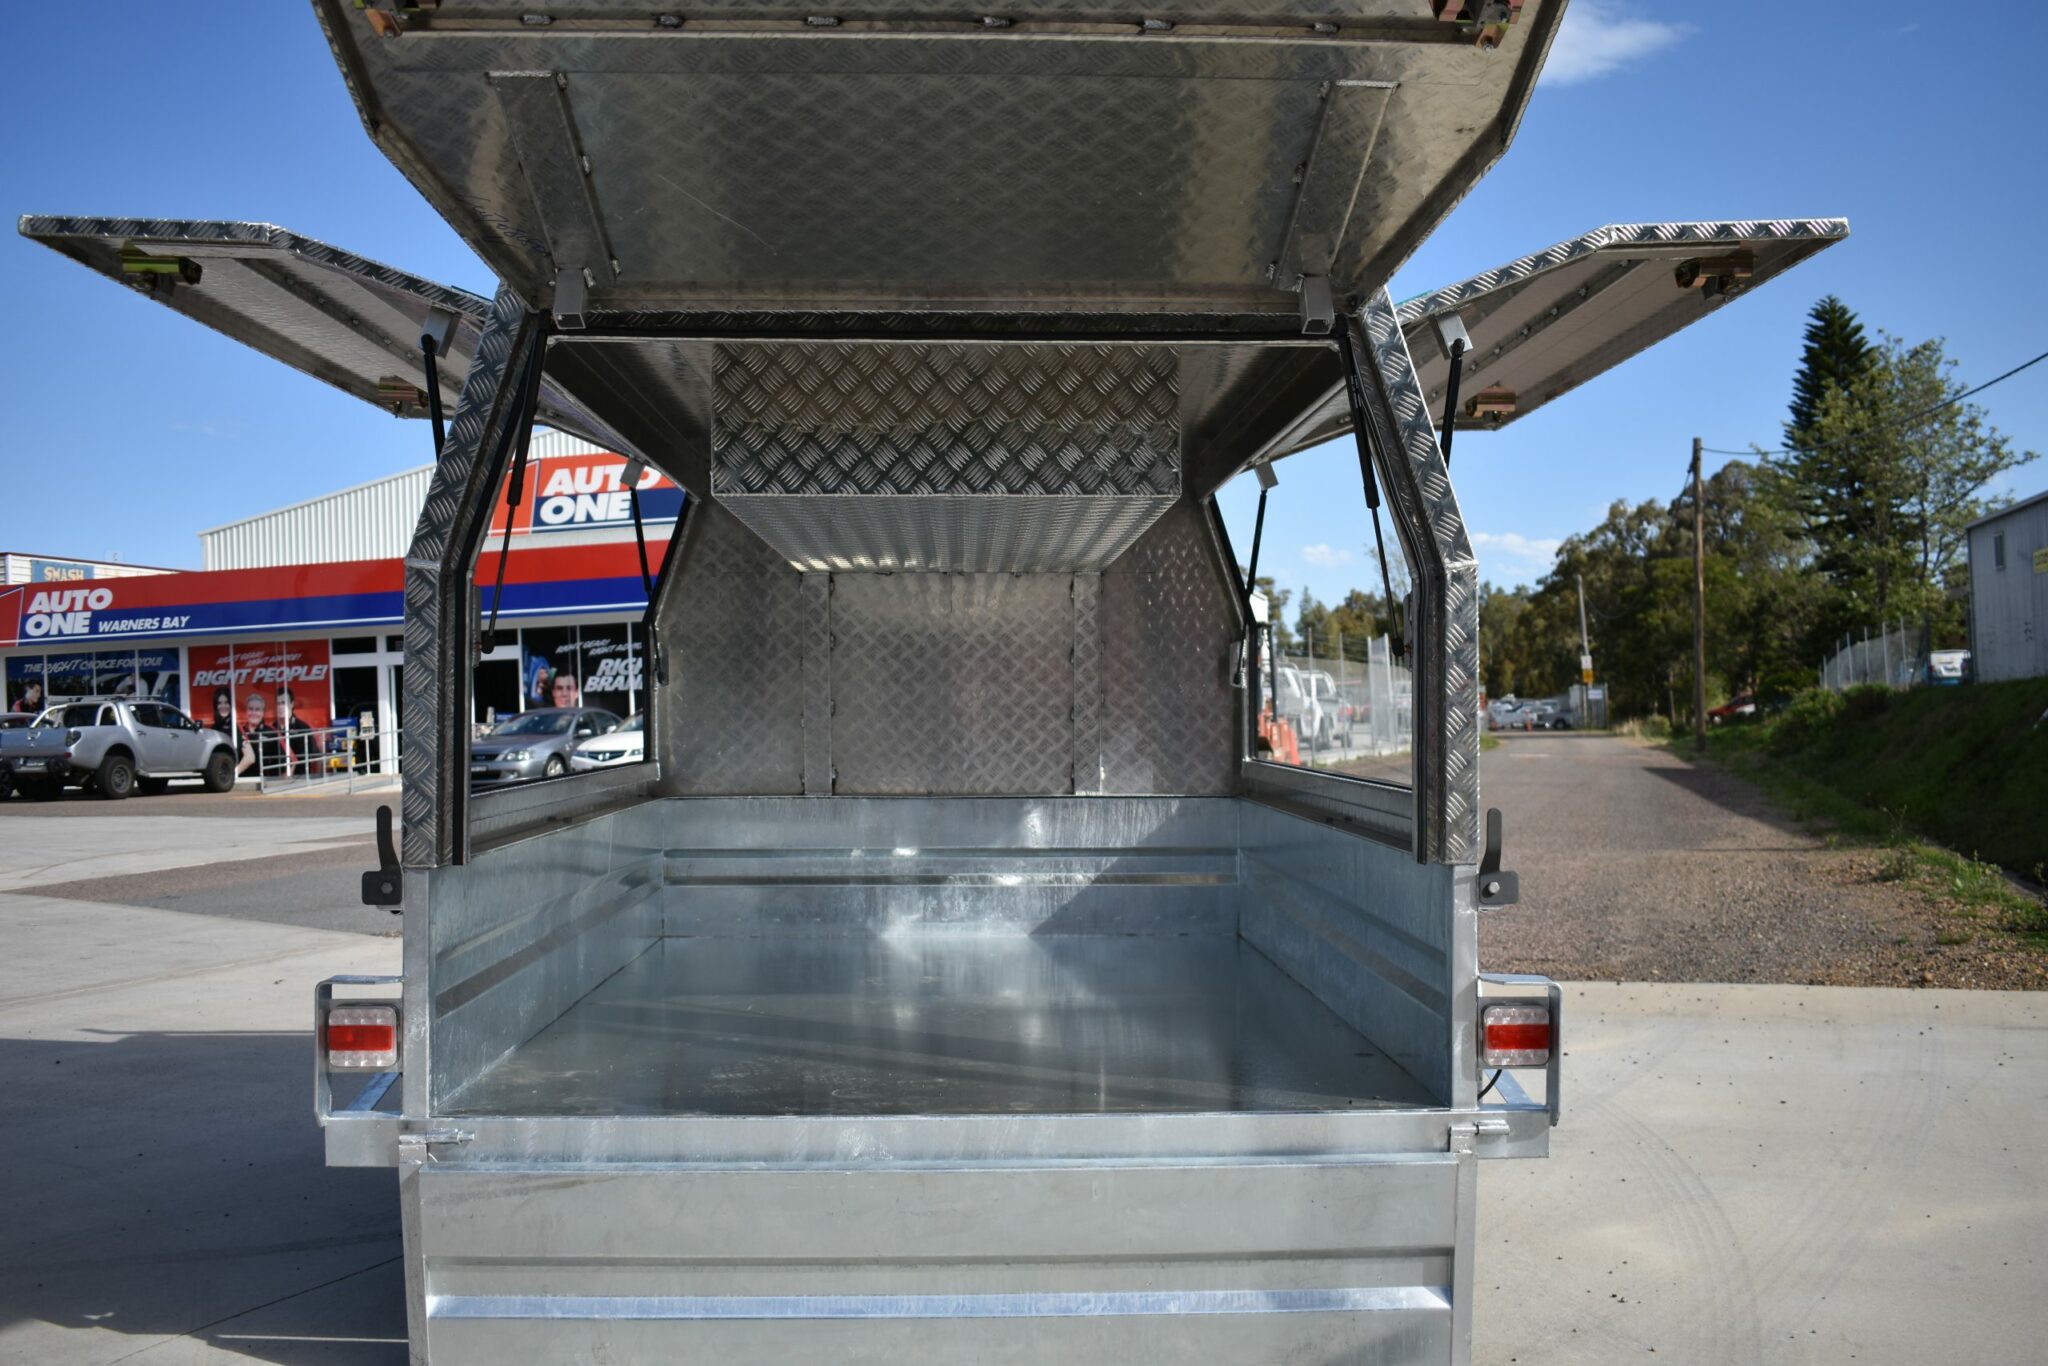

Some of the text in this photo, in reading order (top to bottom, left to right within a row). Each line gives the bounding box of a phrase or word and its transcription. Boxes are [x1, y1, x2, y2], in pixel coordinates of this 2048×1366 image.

[540, 491, 632, 524] ONE
[44, 566, 84, 582] SMASH
[27, 588, 113, 614] AUTO
[25, 611, 92, 636] ONE
[98, 616, 191, 633] WARNERS BAY
[23, 664, 43, 673] THE
[42, 659, 82, 674] RIGHT
[80, 659, 118, 671] CHOICE
[116, 658, 138, 668] FOR
[192, 664, 329, 687] RIGHT PEOPLE!
